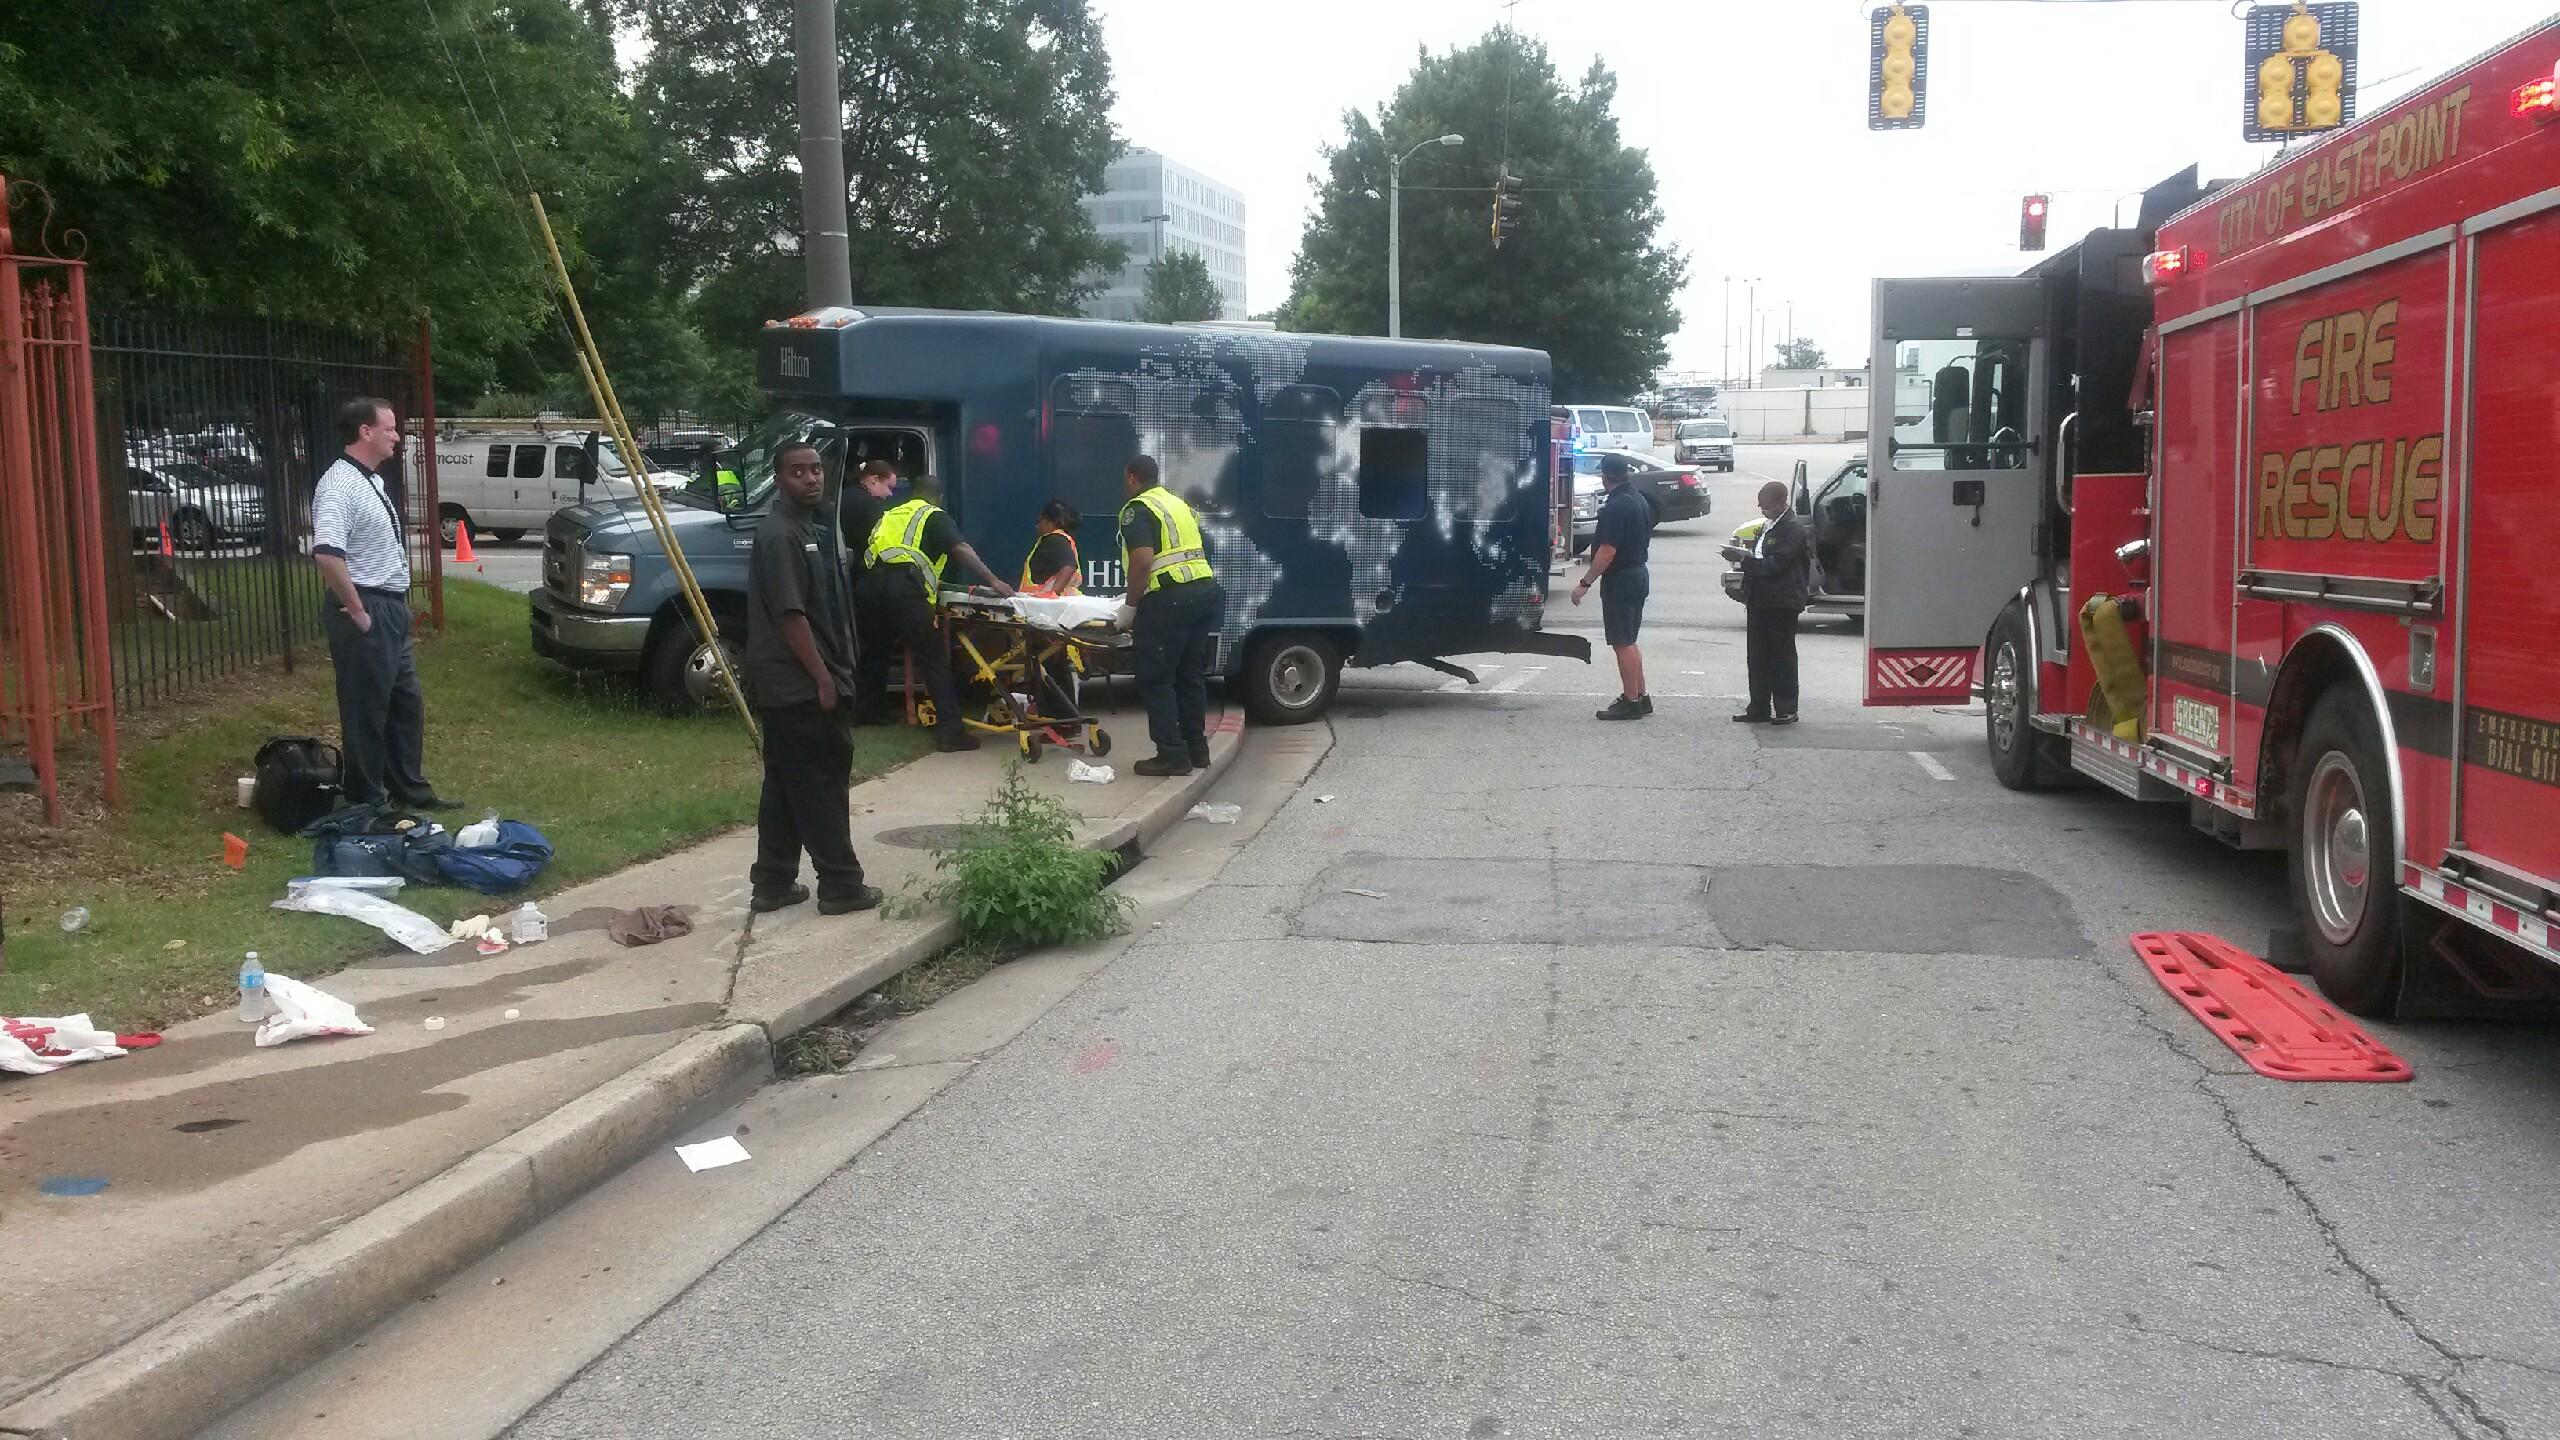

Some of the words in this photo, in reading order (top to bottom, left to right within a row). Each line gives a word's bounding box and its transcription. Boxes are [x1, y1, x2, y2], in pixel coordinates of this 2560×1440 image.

[2218, 197, 2261, 255] CITY
[2265, 172, 2296, 236] OF
[2302, 134, 2369, 218] EAST
[2375, 83, 2471, 188] POINT
[780, 347, 810, 378] Hilton
[2292, 297, 2399, 415] FIRE
[2257, 435, 2443, 544] RESCUE
[2487, 738, 2522, 773] DIAL
[2531, 748, 2558, 783] 911
